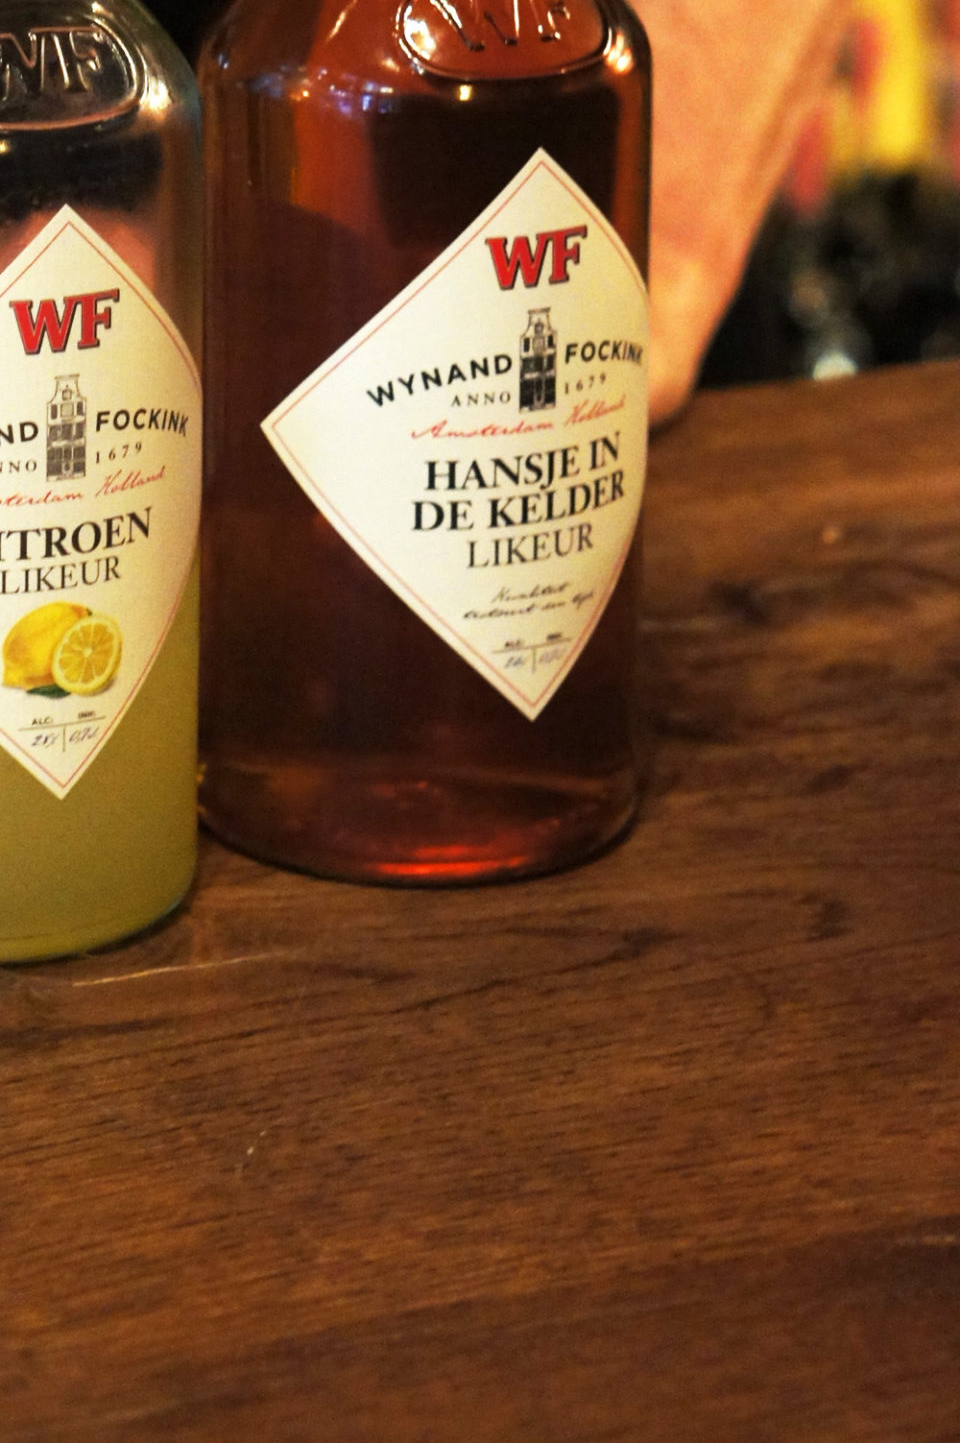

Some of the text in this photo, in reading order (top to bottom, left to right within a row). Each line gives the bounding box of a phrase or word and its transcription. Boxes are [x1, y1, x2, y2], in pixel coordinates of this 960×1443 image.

[485, 223, 588, 291] WF
[9, 288, 120, 355] WF
[366, 354, 513, 407] WYNAND
[451, 371, 607, 407] ANNO 1679
[95, 408, 189, 438] FOCKINK
[411, 419, 555, 439] Amsterdam
[95, 442, 143, 464] 1679
[425, 431, 621, 491] HANSJE IN
[95, 465, 166, 498] Holland
[412, 470, 625, 531] DE KELDER
[467, 523, 594, 568] LIKEUR
[0, 555, 122, 595] LIKEUR
